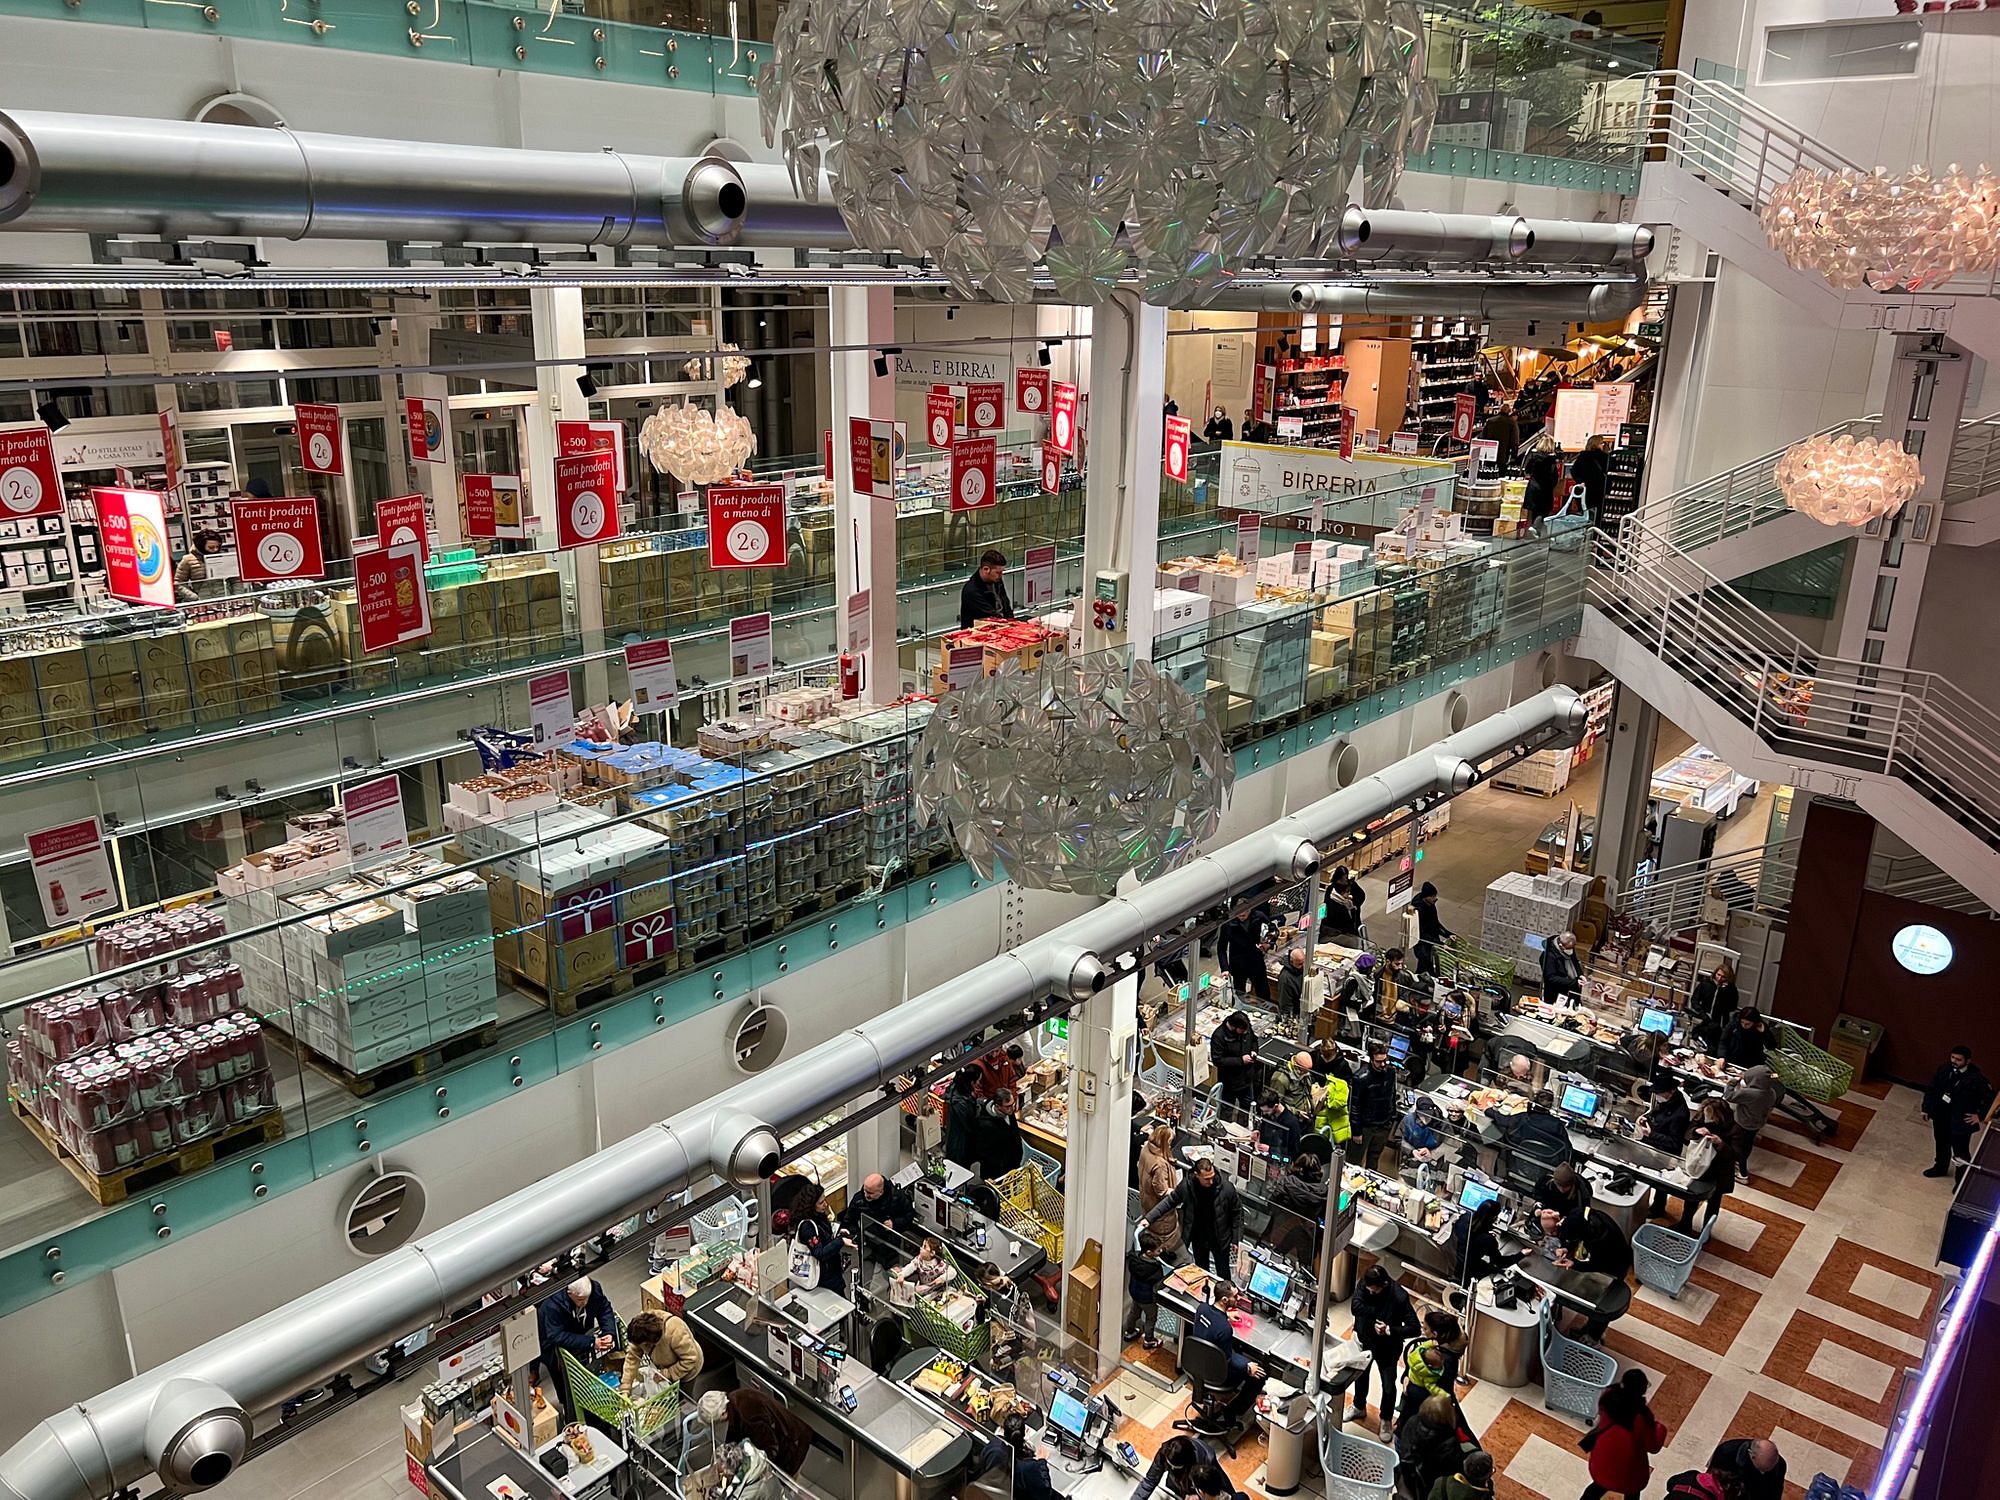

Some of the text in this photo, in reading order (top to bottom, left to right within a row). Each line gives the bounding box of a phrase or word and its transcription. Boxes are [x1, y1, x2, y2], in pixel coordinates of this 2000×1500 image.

[932, 360, 941, 374] E
[946, 361, 996, 379] BIRRA!
[8, 436, 46, 454] prodotti
[570, 438, 586, 447] 500
[858, 437, 868, 446] 500
[0, 451, 39, 465] meno di
[558, 460, 611, 478] Tanti prodotti
[9, 480, 33, 500] 2€
[574, 479, 594, 490] meno
[596, 474, 604, 486] di
[1283, 470, 1376, 496] BIRRERIA
[474, 489, 490, 498] 500
[713, 492, 780, 508] Tanti prodotti
[238, 504, 312, 520] Tanti prodotti
[579, 505, 598, 526] 2€
[732, 510, 758, 518] meno
[762, 506, 771, 516] di
[108, 514, 127, 530] 500
[262, 522, 290, 530] meno
[293, 517, 303, 528] di
[1297, 519, 1356, 536] PINO 1
[737, 532, 760, 550] 2€
[106, 545, 135, 556] OFFERTE
[268, 544, 294, 562] 2€
[369, 572, 386, 586] 500
[362, 598, 392, 612] OFFERTE
